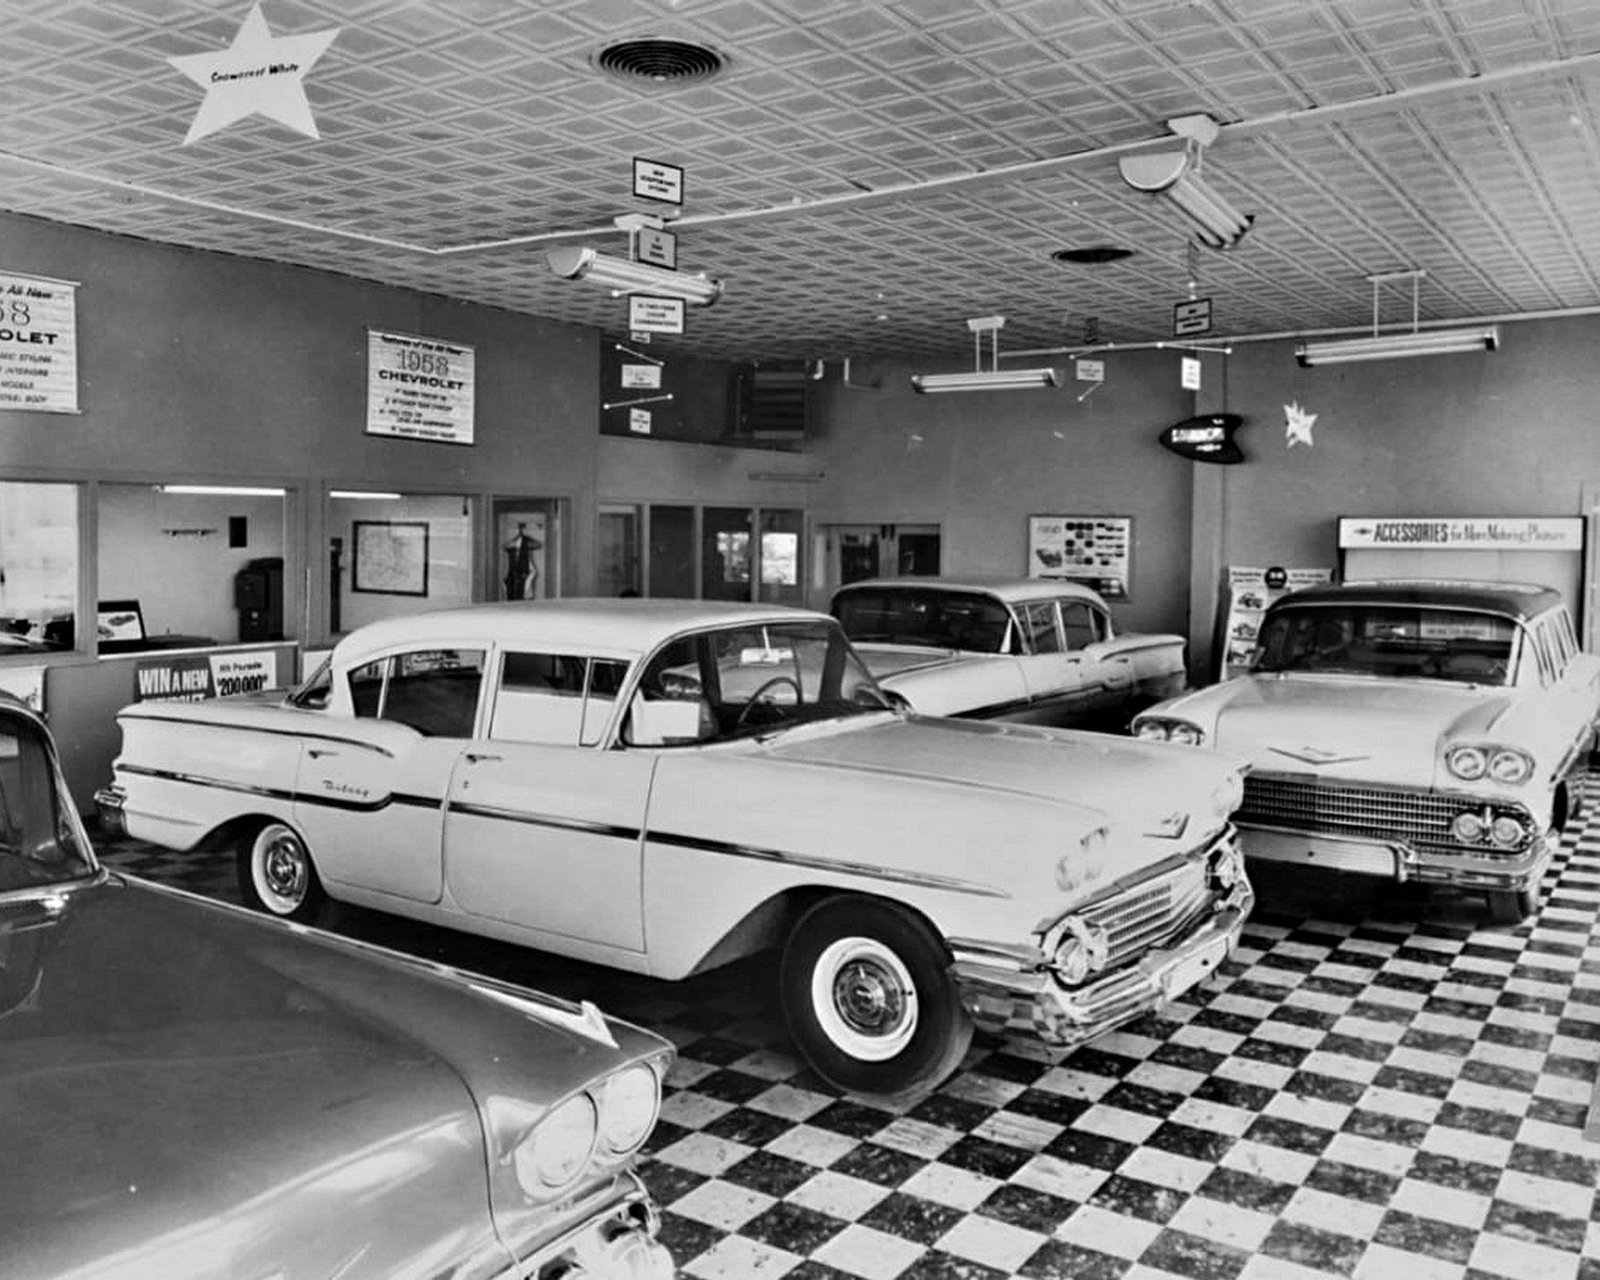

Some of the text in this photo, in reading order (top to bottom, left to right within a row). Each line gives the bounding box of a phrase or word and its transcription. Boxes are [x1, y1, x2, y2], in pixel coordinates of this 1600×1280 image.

[396, 348, 450, 377] 1958
[378, 369, 464, 391] CHEVROLET
[1373, 522, 1449, 543] ACCESSORIES
[139, 667, 209, 695] WIN A NEW
